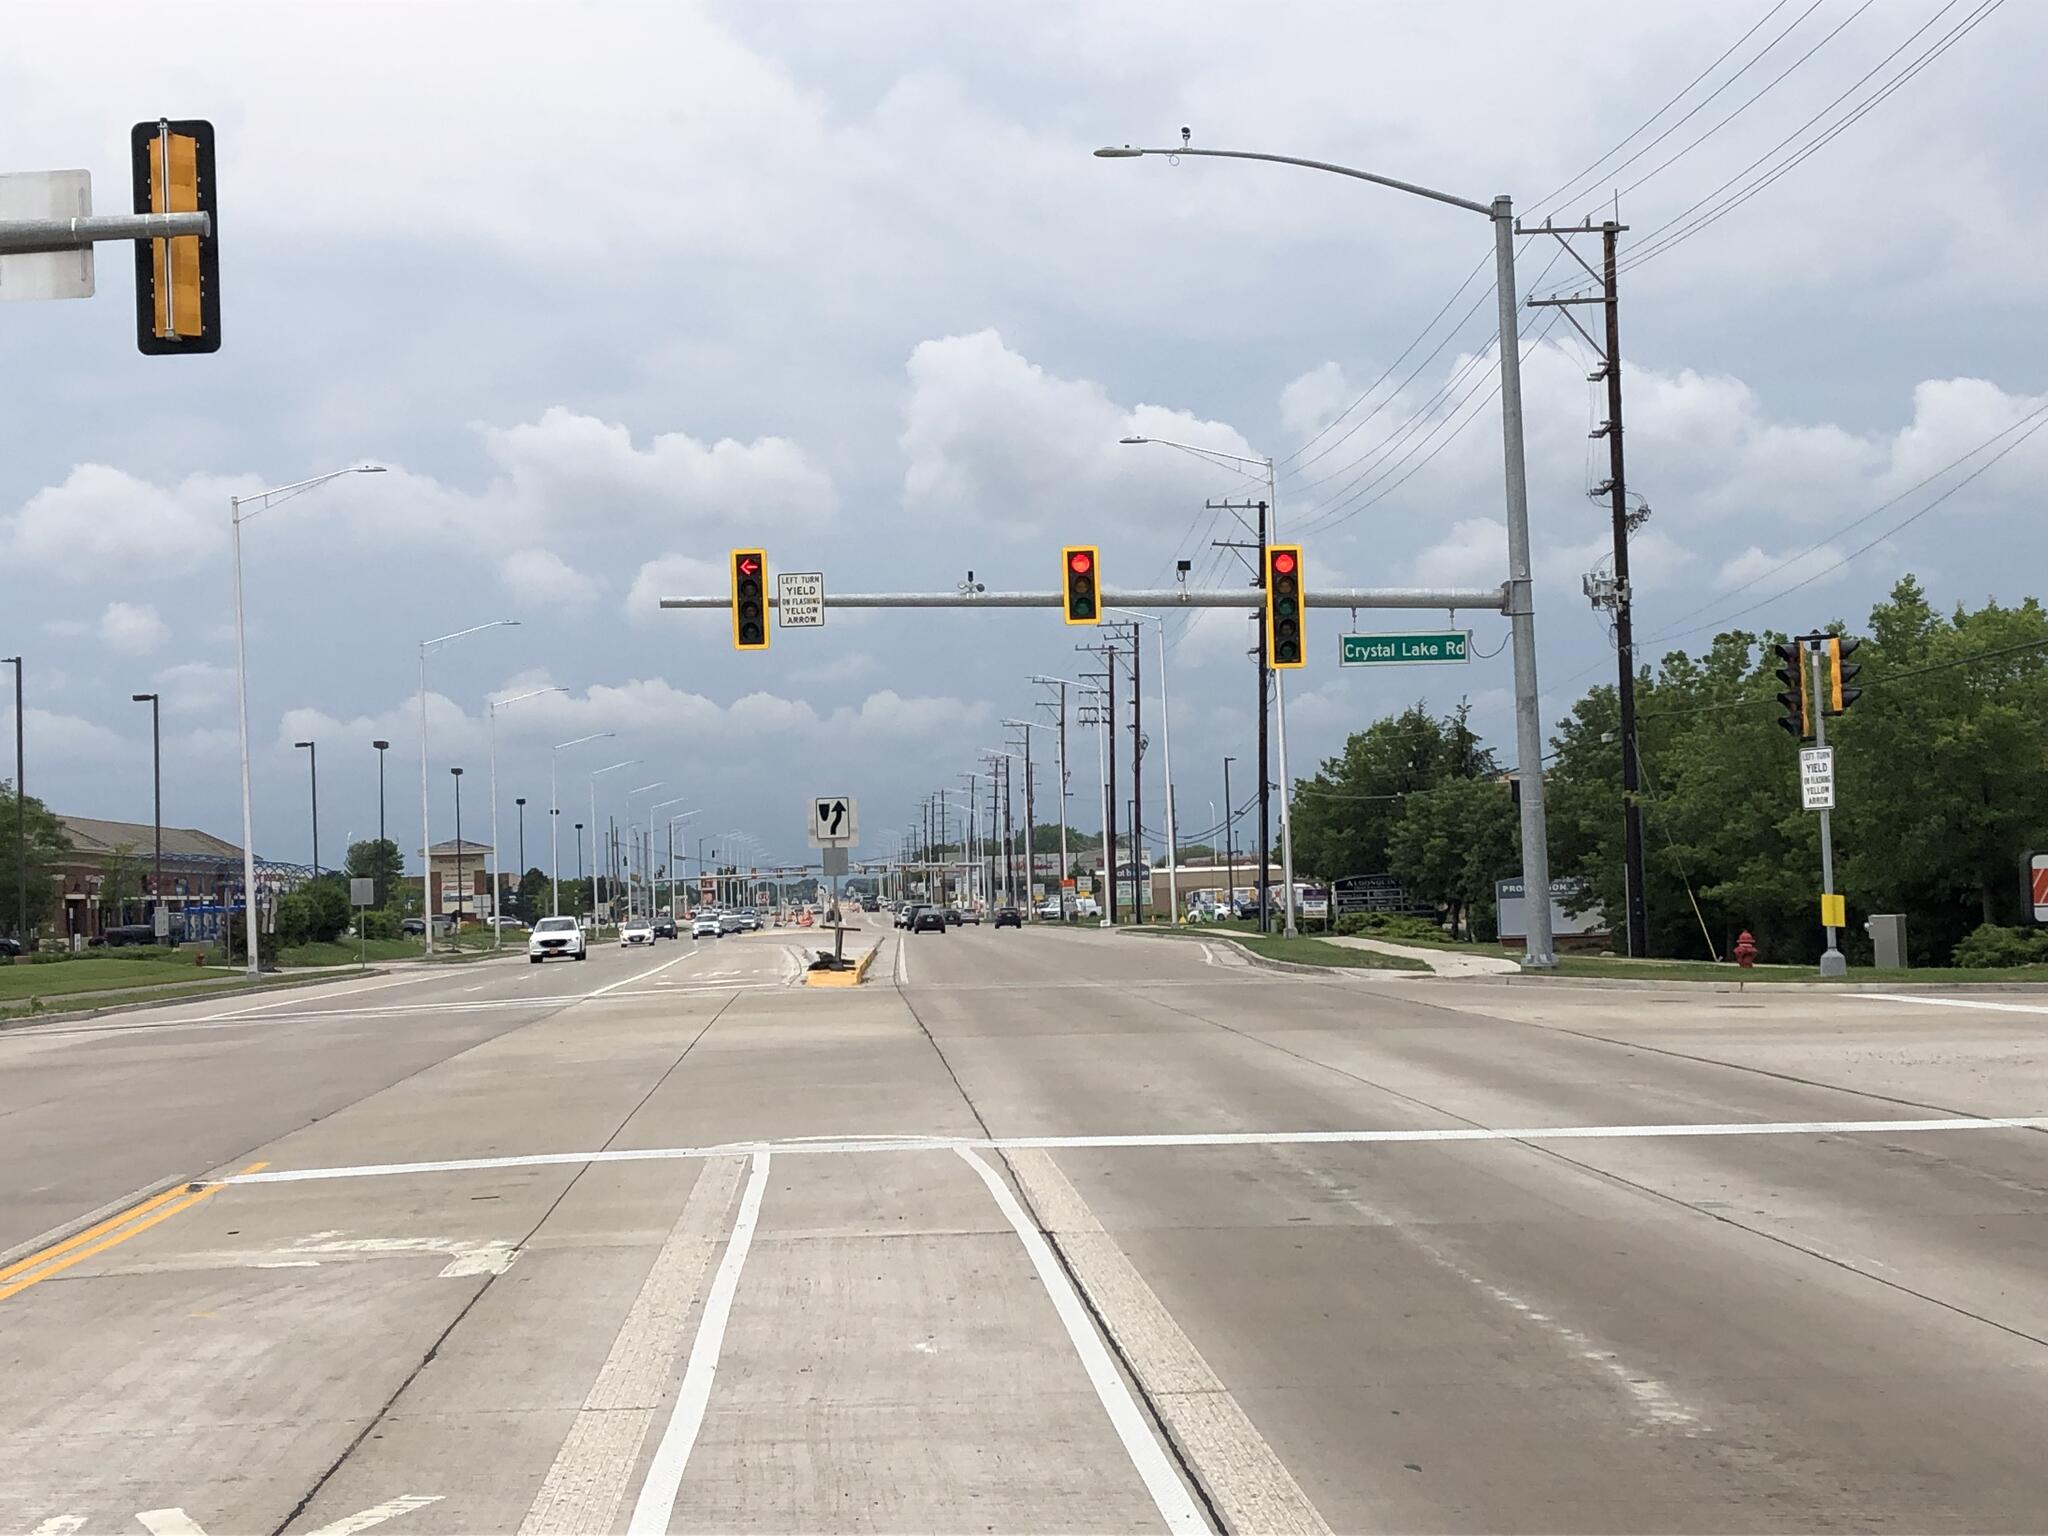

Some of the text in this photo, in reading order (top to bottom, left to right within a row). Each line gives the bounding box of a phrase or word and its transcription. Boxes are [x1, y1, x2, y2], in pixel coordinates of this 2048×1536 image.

[781, 575, 820, 585] LEFT TURN
[786, 586, 816, 596] YIELD
[785, 606, 818, 615] YELLOW
[786, 616, 817, 625] ARROW
[1344, 640, 1466, 661] Crystal Lake Rd
[1806, 762, 1828, 773] YIELD
